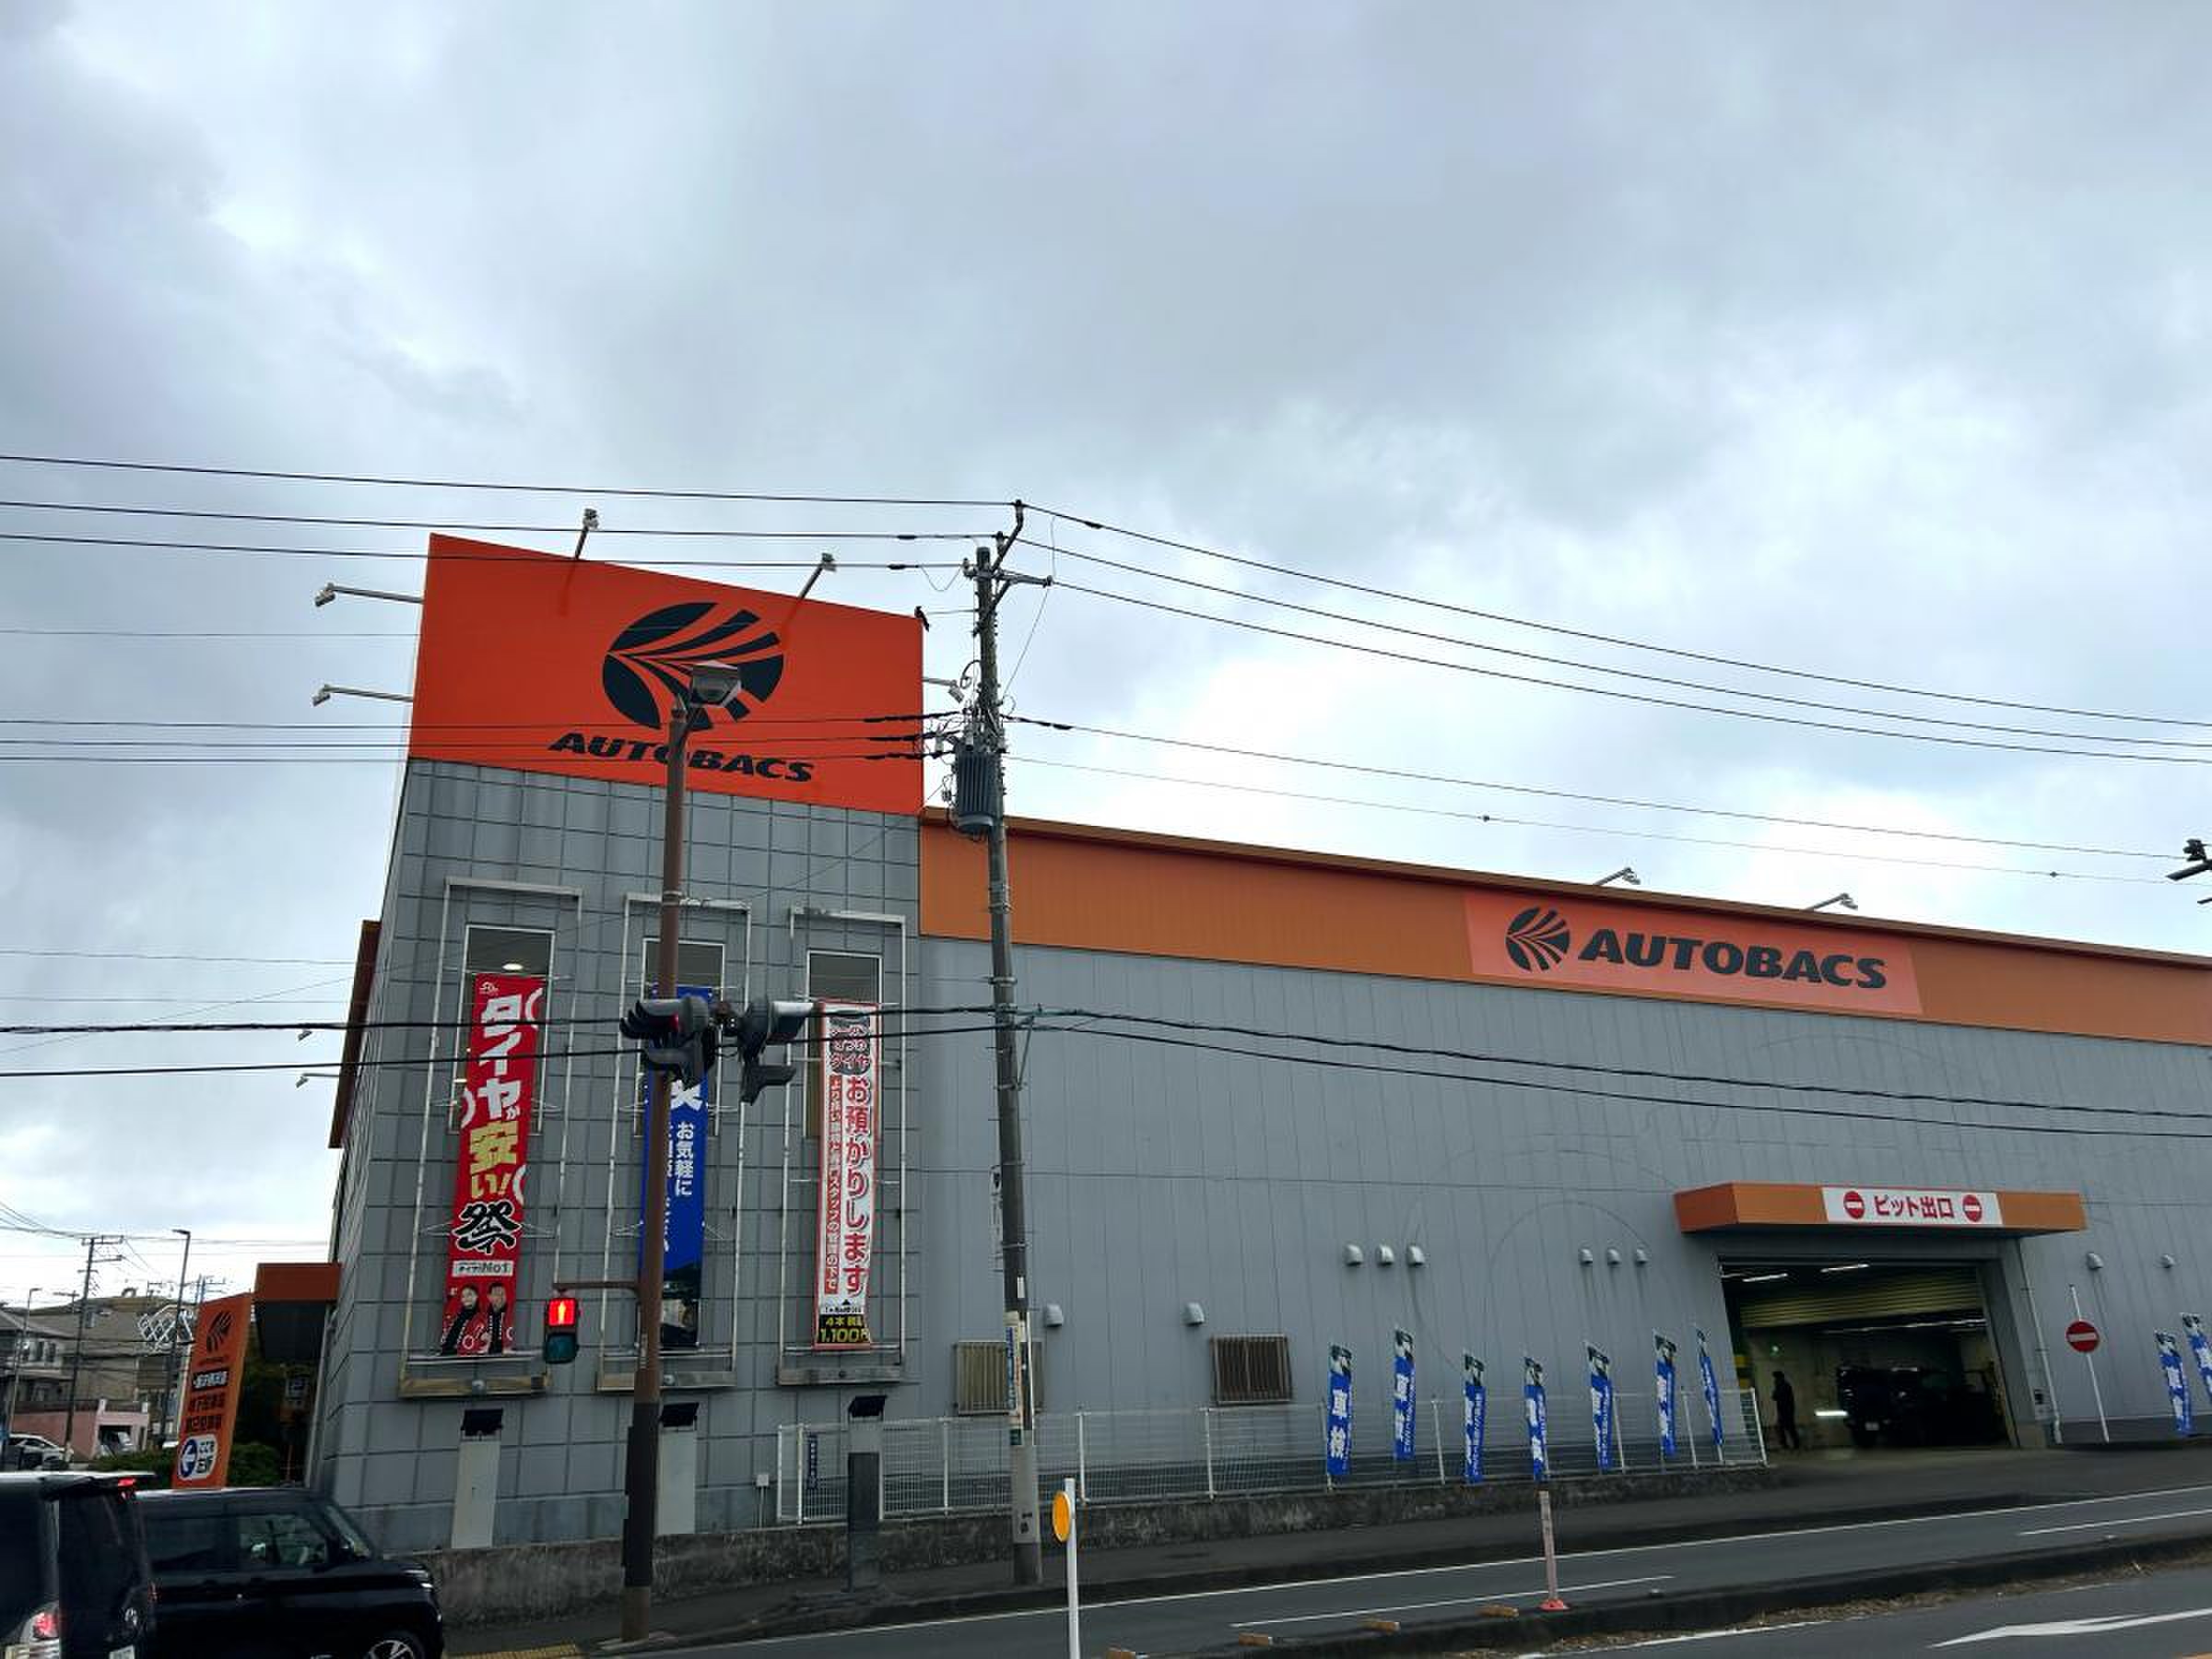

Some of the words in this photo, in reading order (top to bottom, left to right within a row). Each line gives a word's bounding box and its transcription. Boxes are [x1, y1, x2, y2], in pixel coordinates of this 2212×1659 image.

[1577, 928, 1887, 989] AUTOBACS
[675, 1121, 695, 1196] お気軽に
[842, 1075, 871, 1297] お預かりします
[1873, 1194, 1956, 1219] ピット出口
